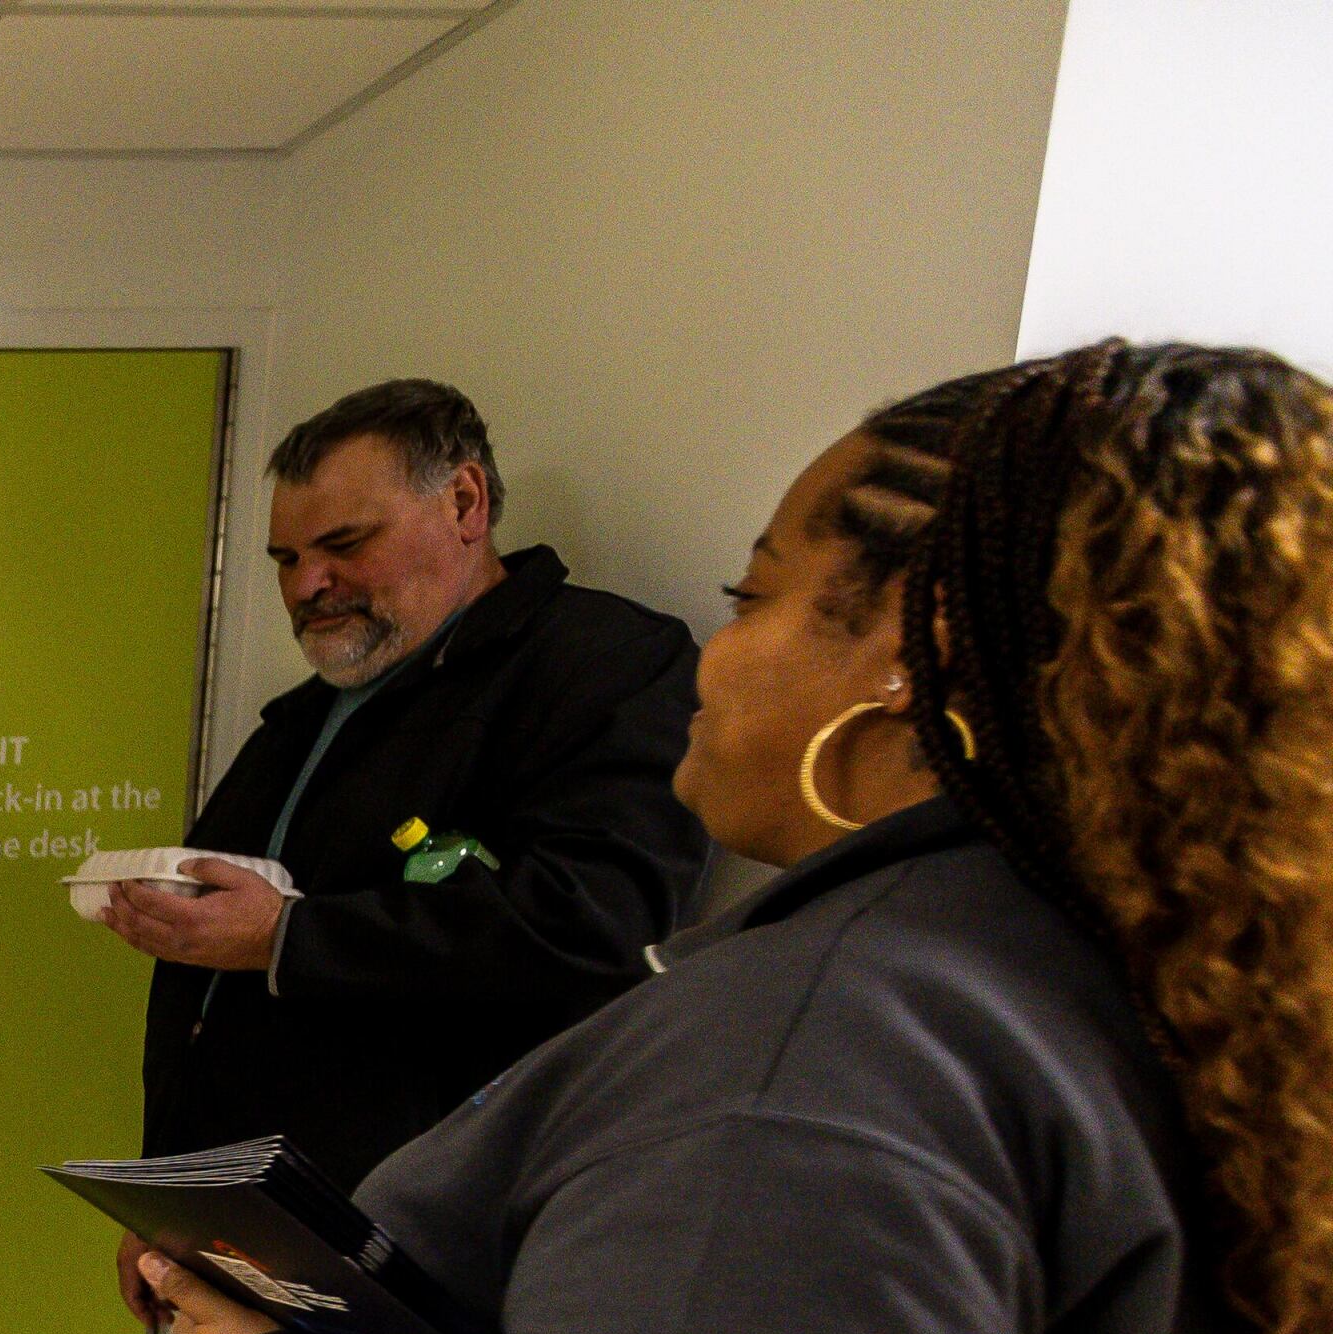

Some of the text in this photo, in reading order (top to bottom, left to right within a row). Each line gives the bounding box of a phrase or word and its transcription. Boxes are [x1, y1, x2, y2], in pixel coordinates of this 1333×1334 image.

[71, 784, 102, 812] at
[110, 780, 162, 811] the
[29, 827, 101, 859] desk
